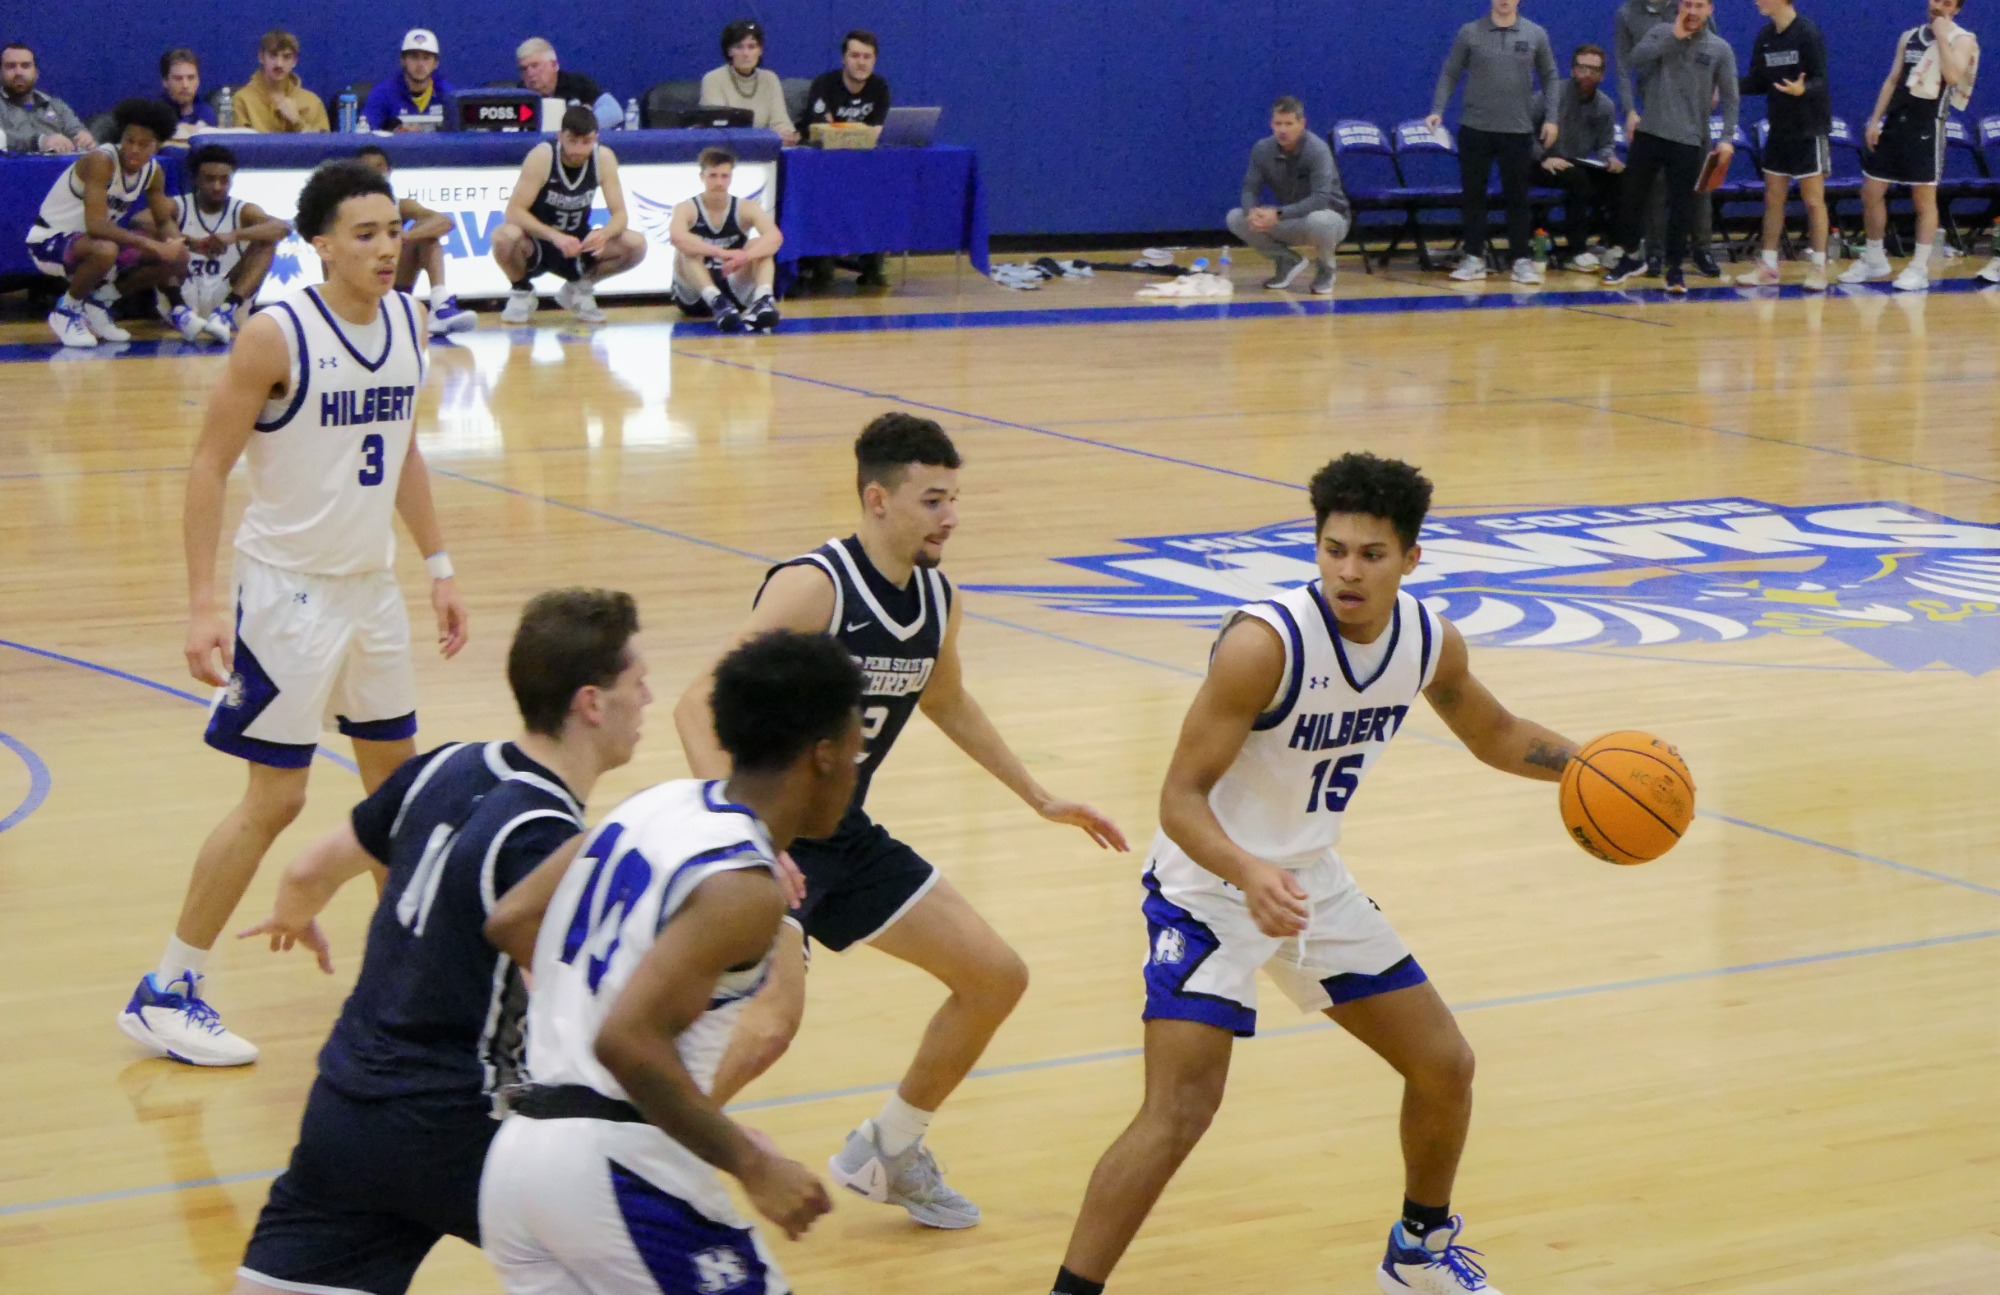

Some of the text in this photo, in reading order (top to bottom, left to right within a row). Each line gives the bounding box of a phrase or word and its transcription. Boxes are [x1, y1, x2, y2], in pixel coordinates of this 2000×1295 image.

[407, 186, 488, 202] HILBERT
[320, 385, 415, 427] HILBERT
[359, 433, 384, 487] 3
[1476, 502, 1772, 531] COLLEGE
[1288, 705, 1409, 752] HILBERT
[1306, 753, 1365, 813] 15
